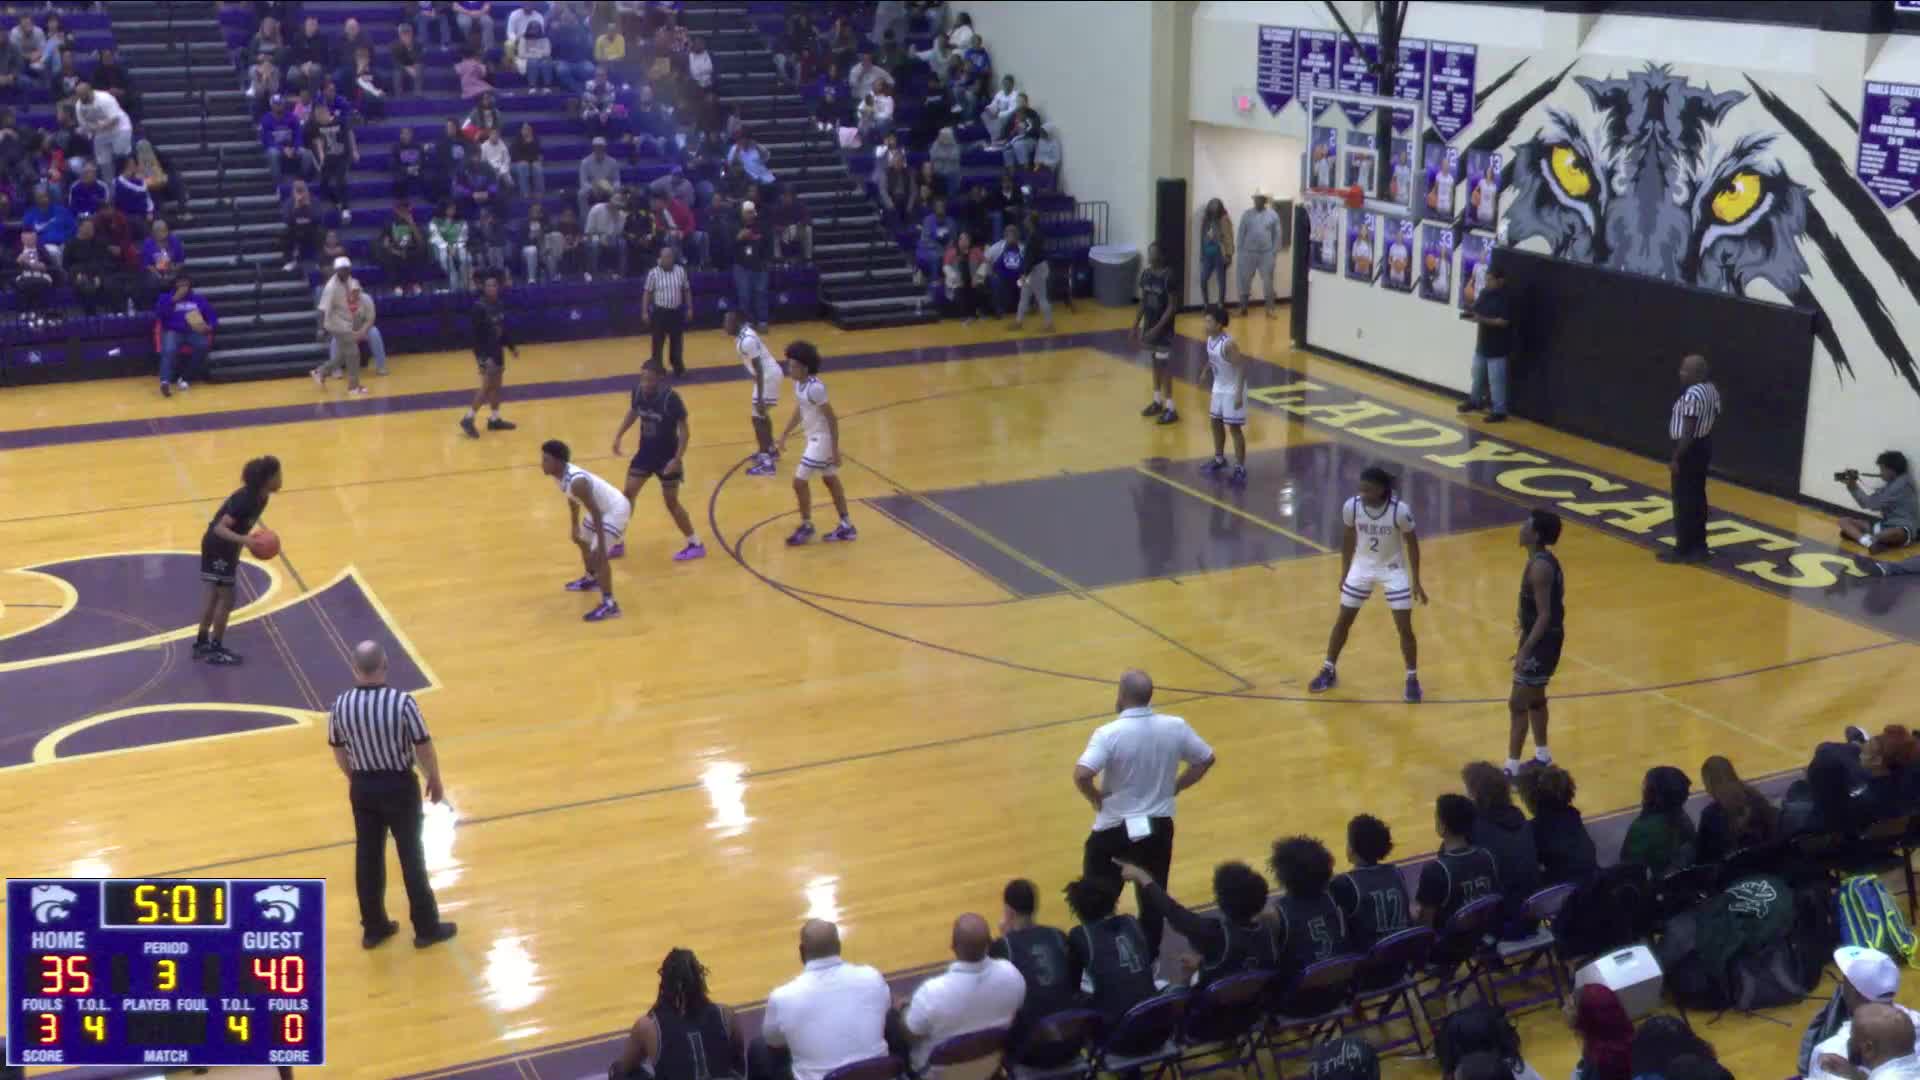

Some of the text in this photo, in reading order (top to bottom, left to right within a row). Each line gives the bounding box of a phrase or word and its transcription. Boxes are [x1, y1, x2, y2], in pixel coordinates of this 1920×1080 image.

[1446, 148, 1458, 167] 12
[1489, 155, 1502, 174] 13
[1439, 230, 1453, 248] 33
[1369, 537, 1380, 553] 2
[1115, 935, 1142, 973] 4
